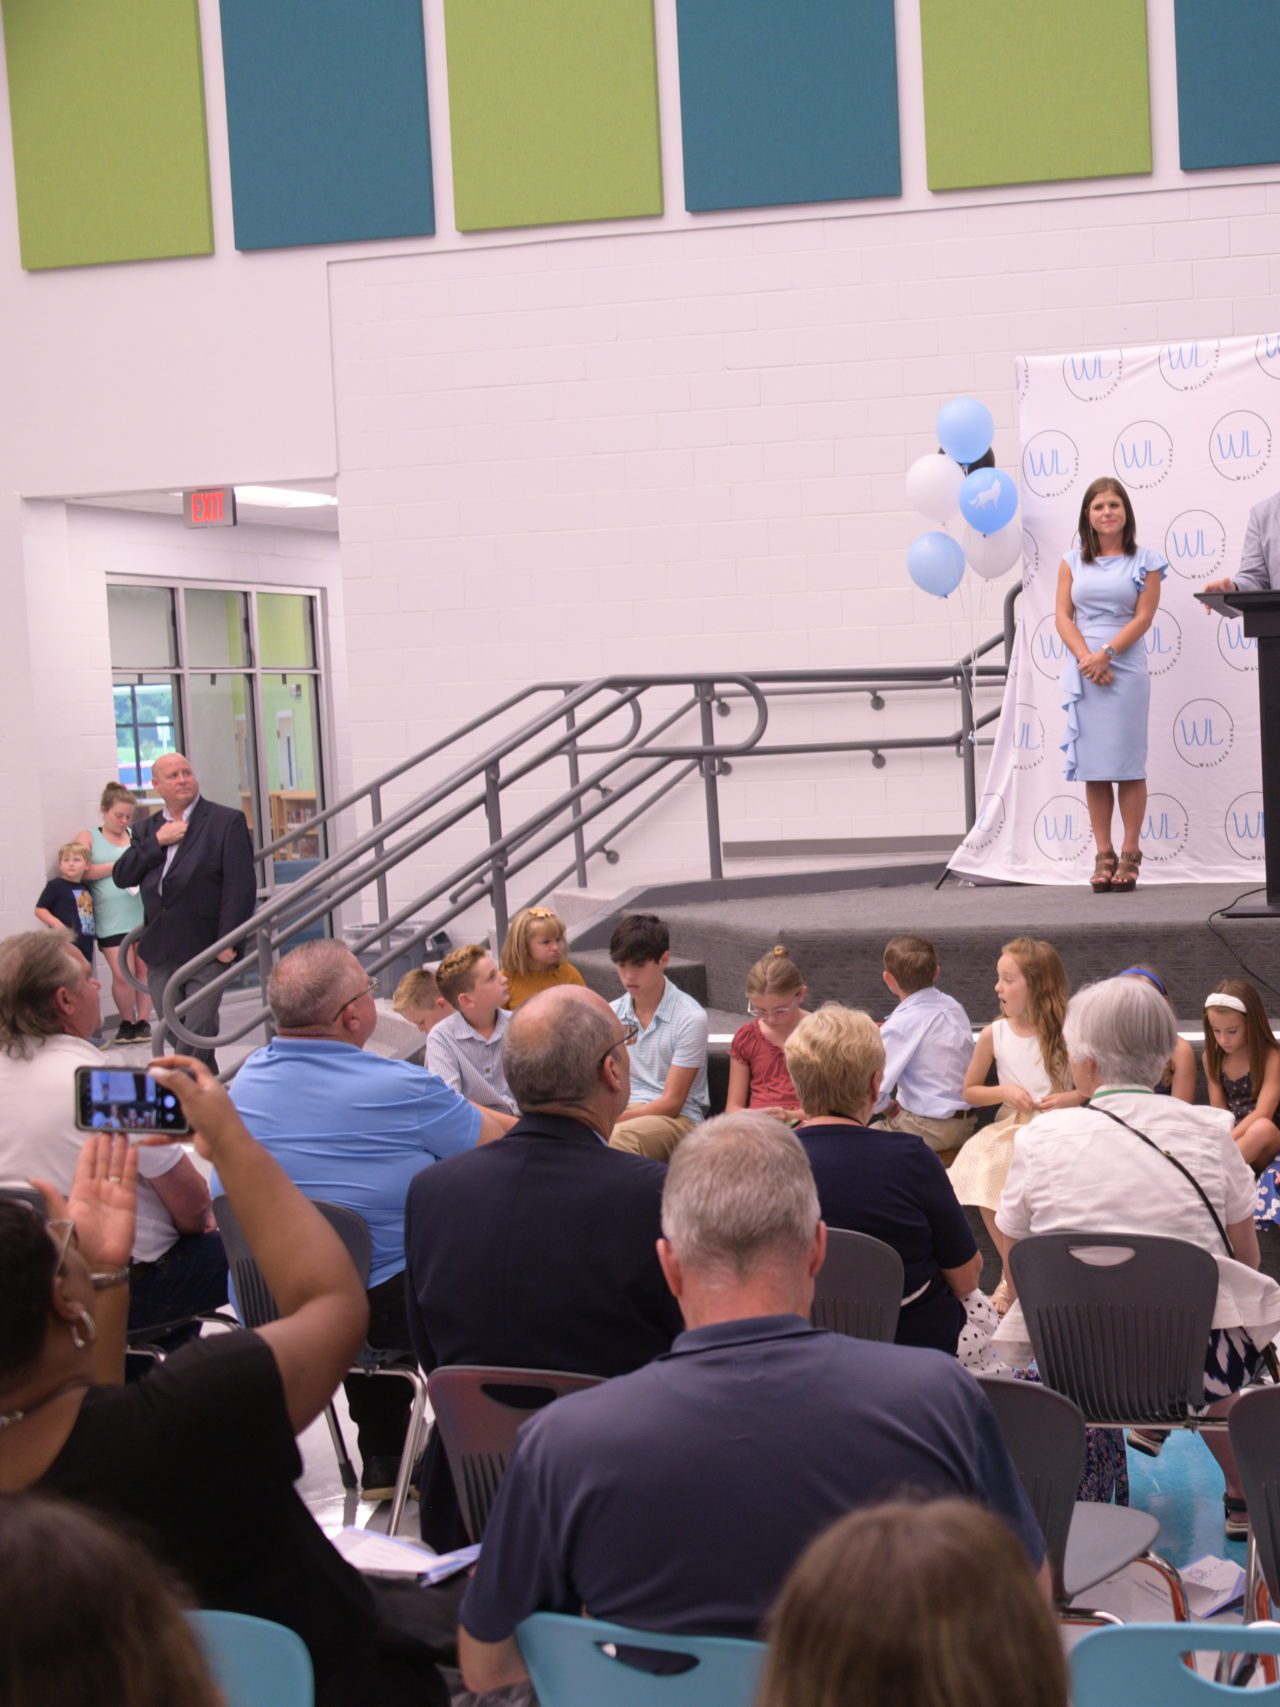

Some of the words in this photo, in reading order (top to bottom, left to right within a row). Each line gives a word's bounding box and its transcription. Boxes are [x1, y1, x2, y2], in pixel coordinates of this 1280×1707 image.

[1071, 354, 1112, 381] WL
[1168, 342, 1209, 370] WL
[1120, 440, 1163, 468] WL
[1217, 430, 1260, 460] WL
[1029, 448, 1068, 477] WL
[192, 491, 224, 522] EXIT
[1172, 529, 1216, 558] WL
[1181, 718, 1223, 746] WL
[1044, 814, 1082, 841] WL
[1140, 813, 1179, 840] WL
